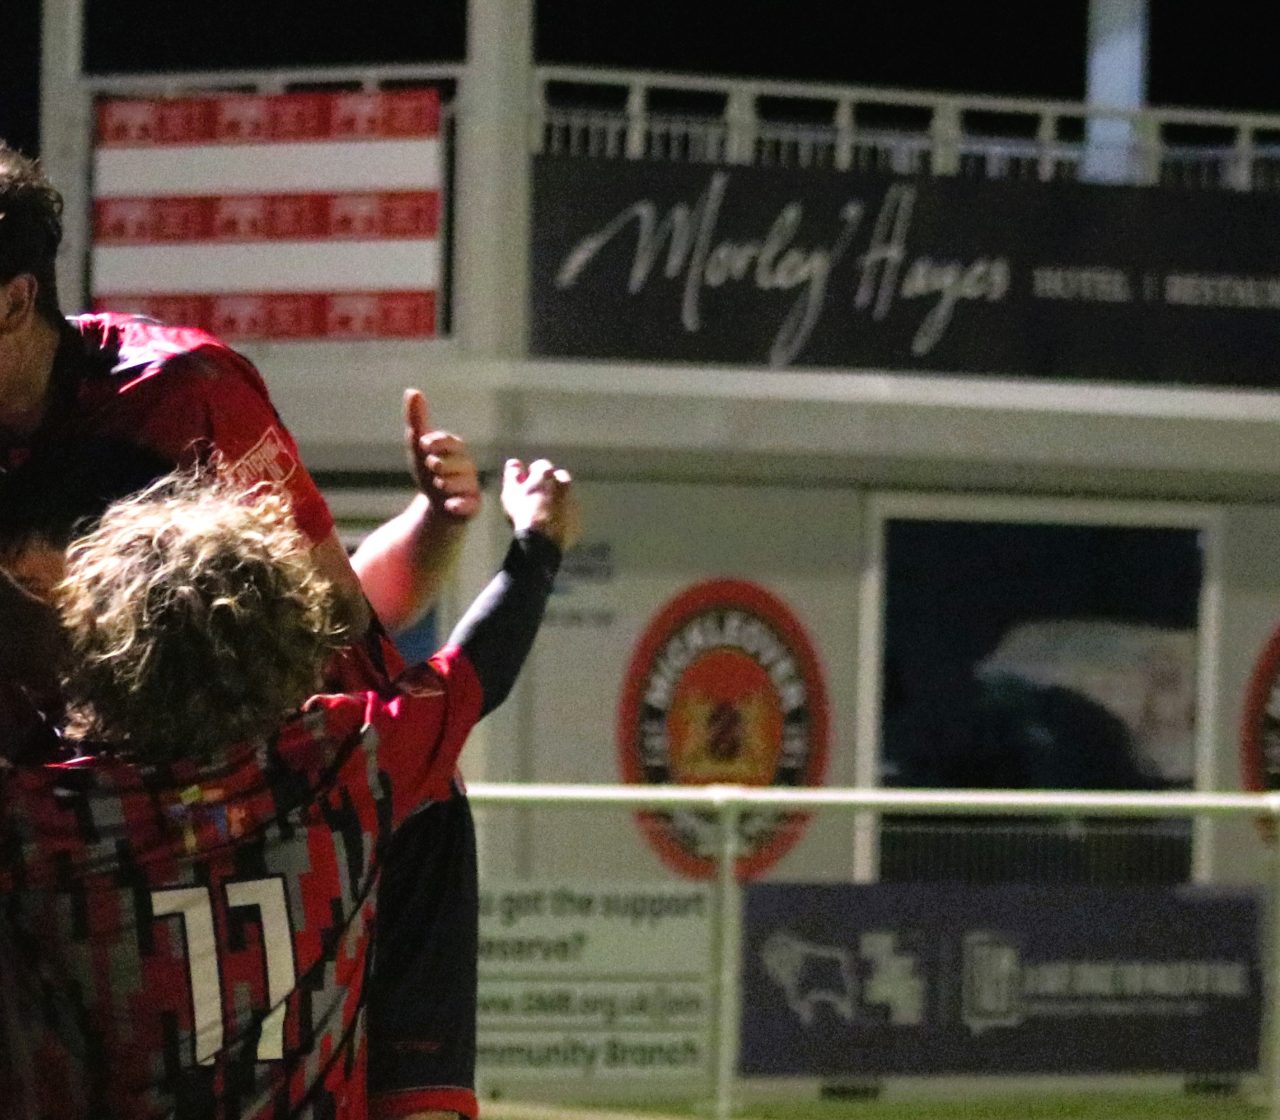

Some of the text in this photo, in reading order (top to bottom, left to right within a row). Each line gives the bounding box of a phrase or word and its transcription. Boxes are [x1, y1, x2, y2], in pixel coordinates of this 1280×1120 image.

[853, 183, 1011, 356] Hayes
[500, 891, 544, 926] got
[550, 889, 594, 916] the
[600, 891, 706, 928] support
[478, 932, 586, 962] eserve?
[150, 876, 296, 1066] 11
[477, 1037, 698, 1078] mmunity Branch
